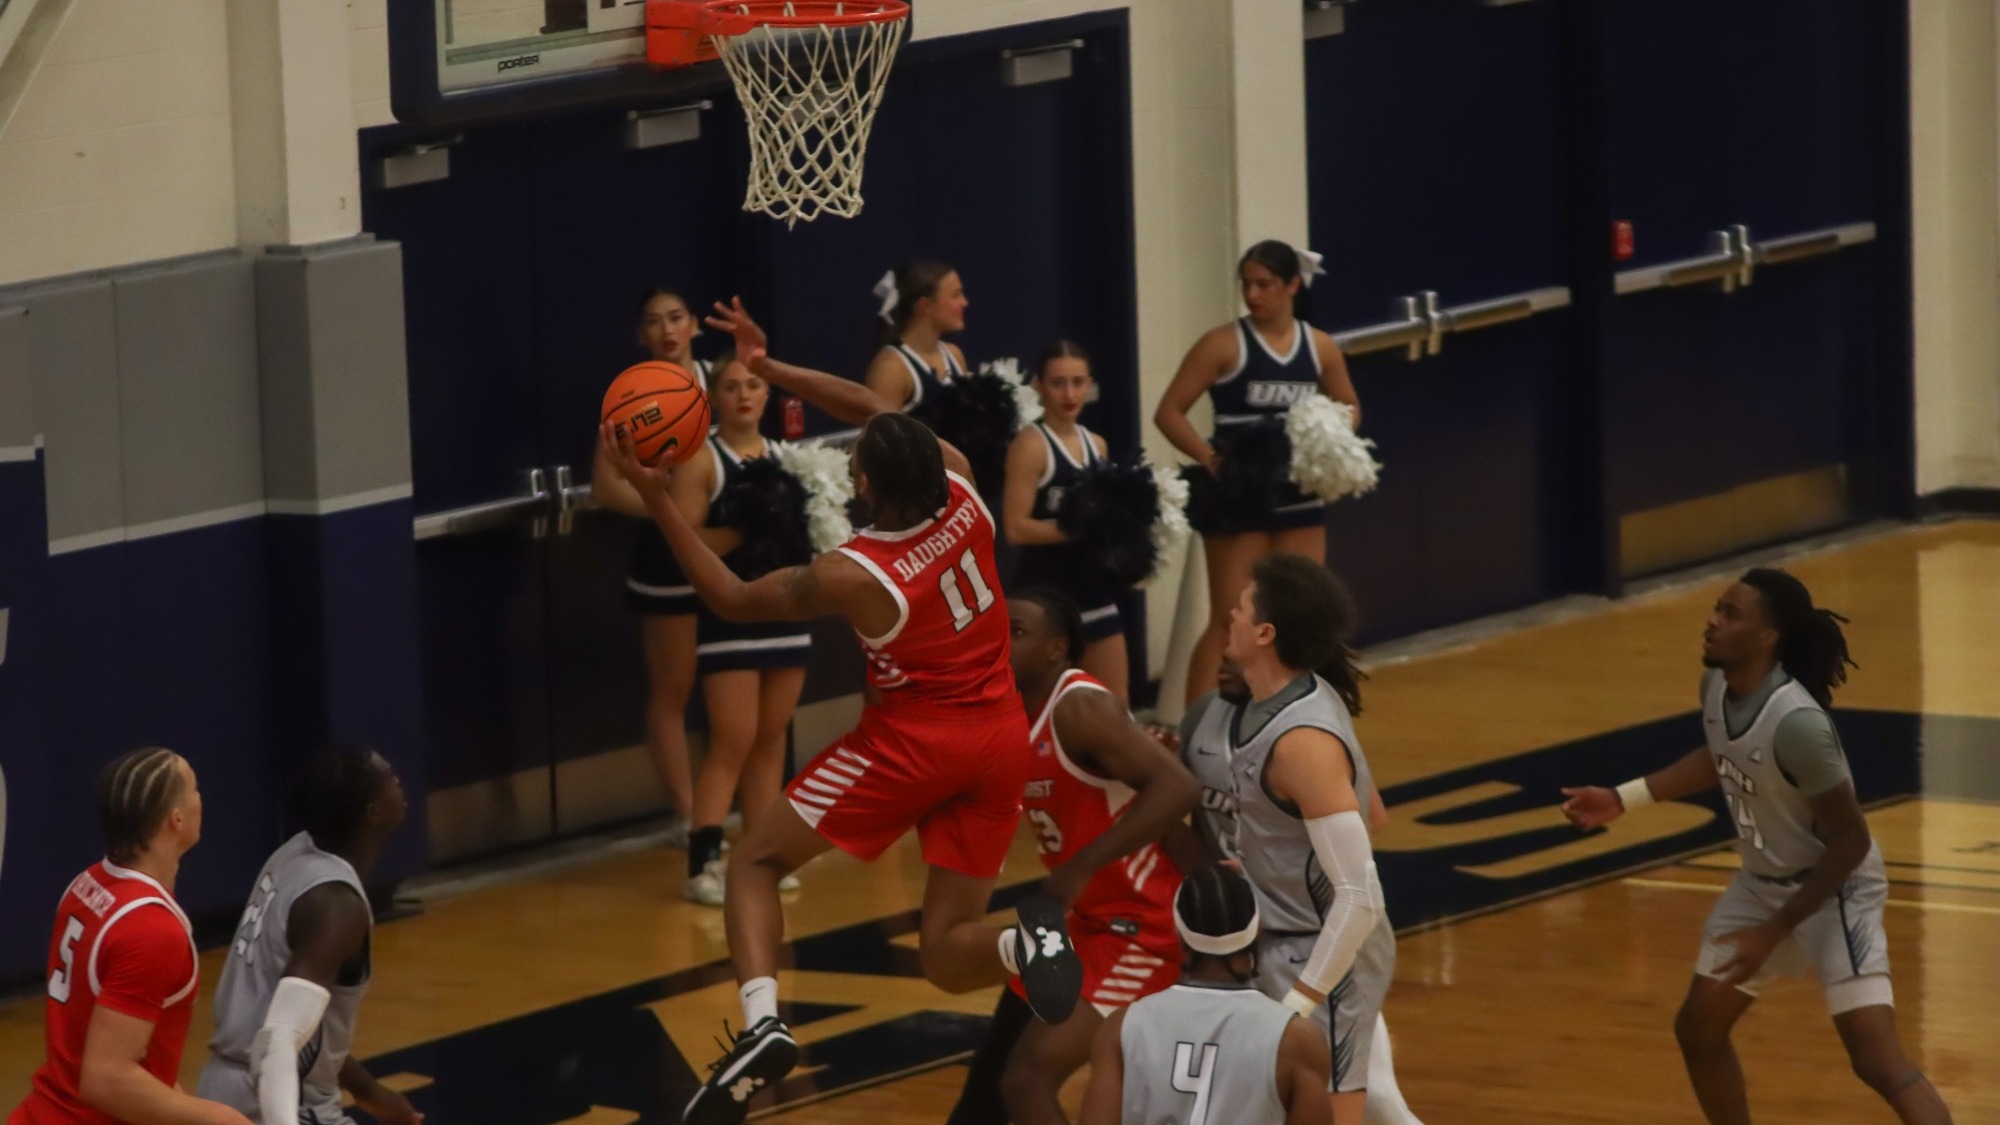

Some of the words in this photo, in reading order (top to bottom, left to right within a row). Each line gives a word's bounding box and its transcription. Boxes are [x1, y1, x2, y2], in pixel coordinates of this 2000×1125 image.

[892, 497, 978, 583] DAUGHTRY
[938, 547, 996, 633] 11
[47, 914, 86, 1004] 5
[1170, 1040, 1220, 1125] 4
